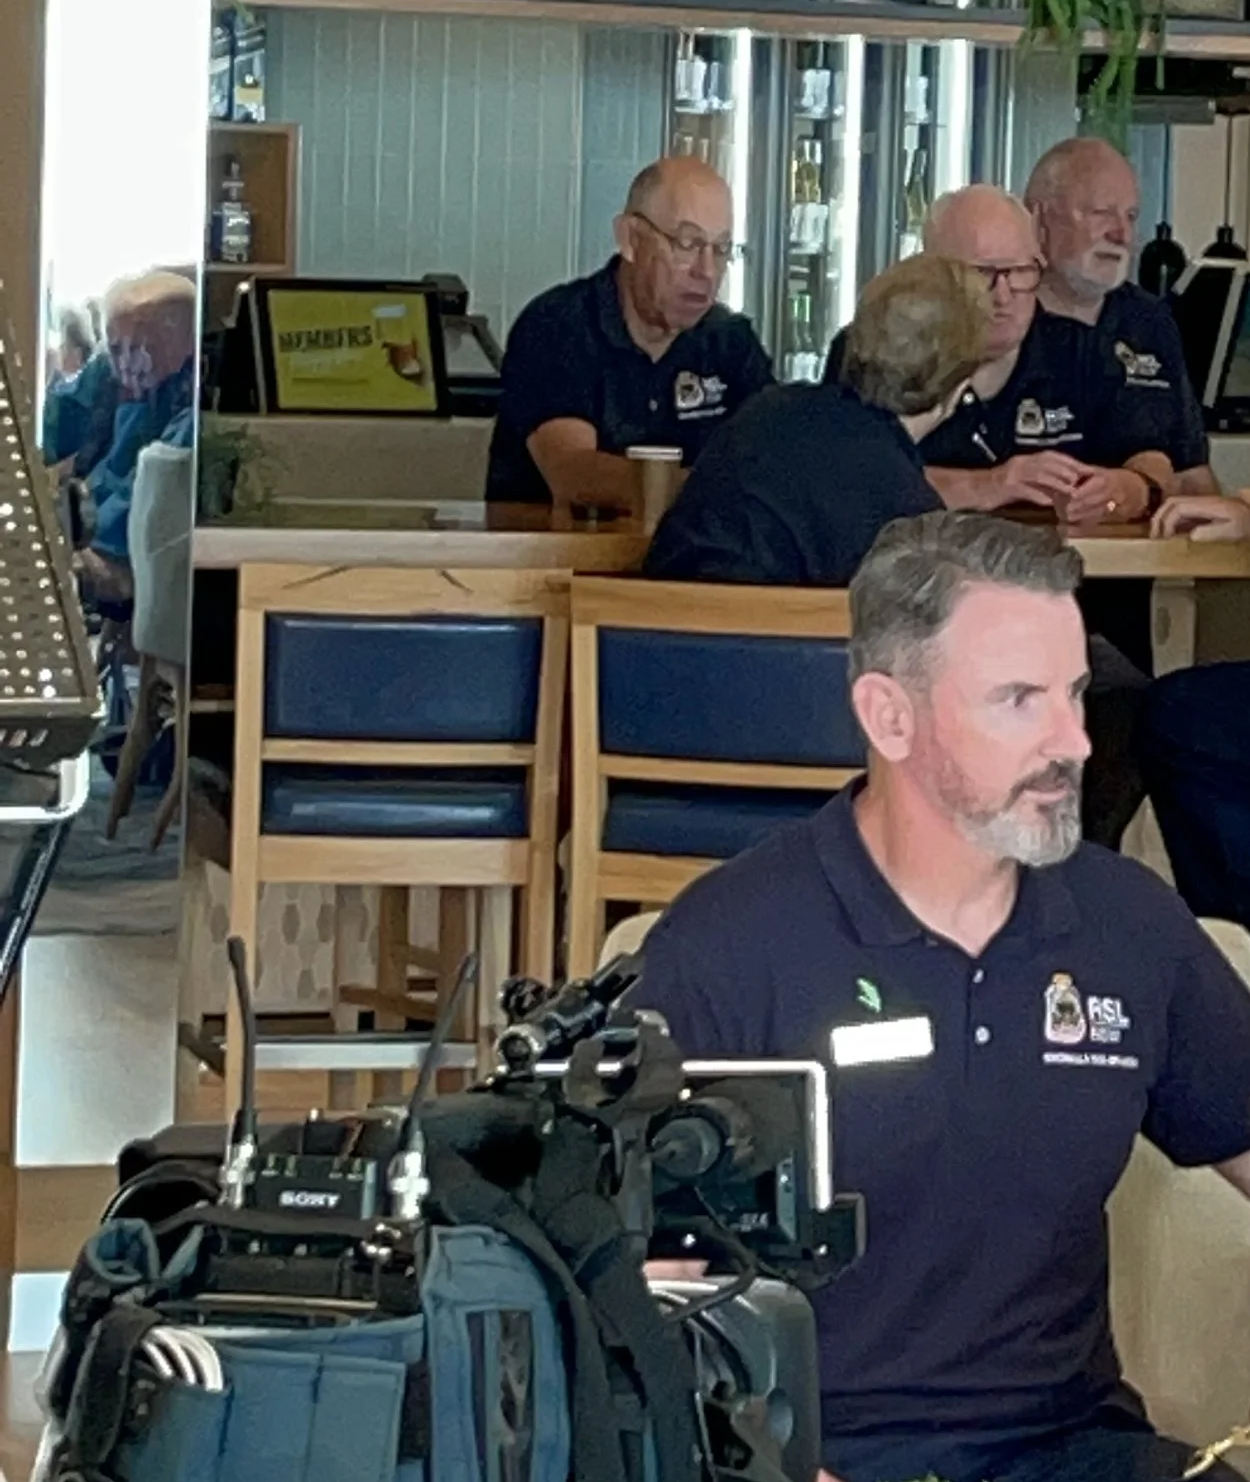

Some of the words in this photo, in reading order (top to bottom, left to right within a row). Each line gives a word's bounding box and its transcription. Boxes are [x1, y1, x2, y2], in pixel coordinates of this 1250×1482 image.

[278, 326, 373, 353] MEMBERS
[1087, 995, 1129, 1026] RSL
[279, 1190, 340, 1208] SONY
